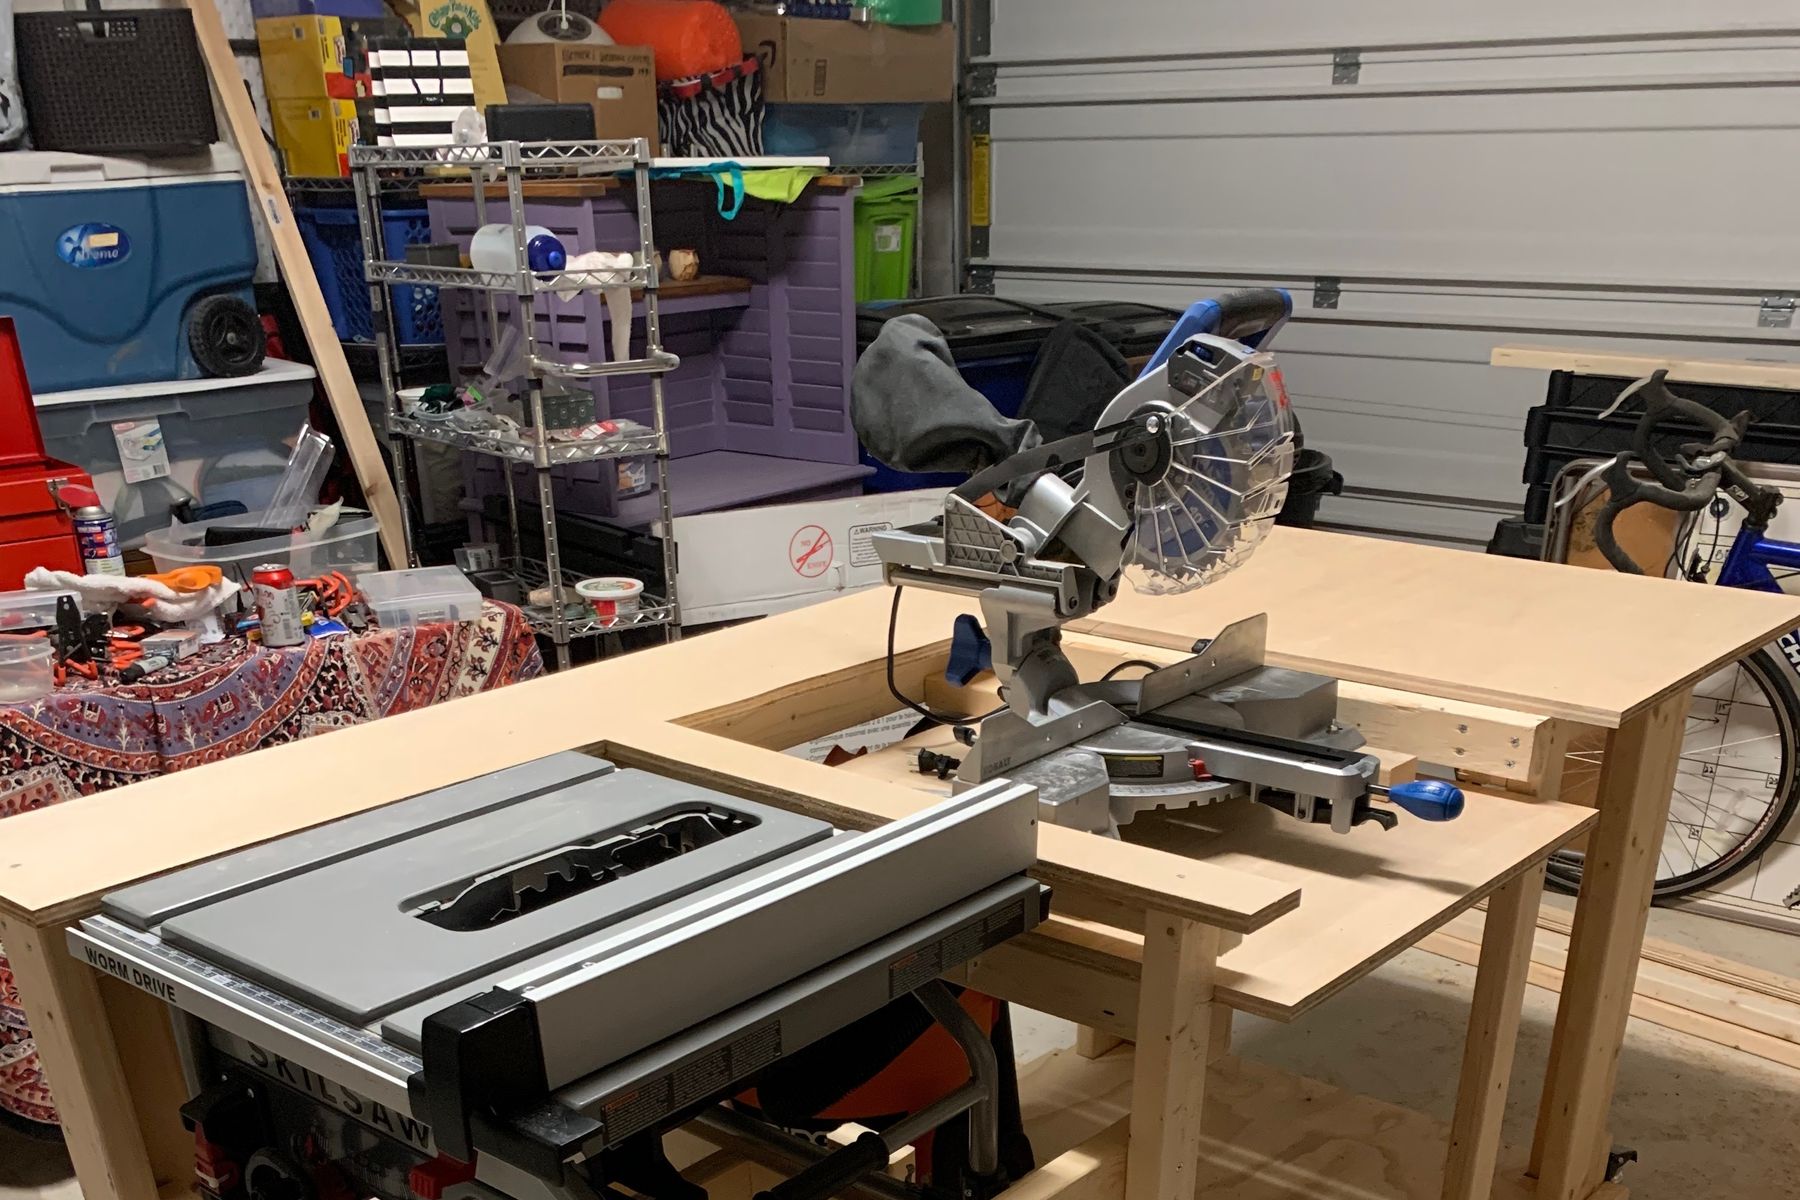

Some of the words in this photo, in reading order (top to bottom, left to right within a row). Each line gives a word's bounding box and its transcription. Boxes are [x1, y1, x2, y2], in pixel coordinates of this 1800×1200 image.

[84, 945, 130, 981] WORM
[132, 968, 177, 1003] DRIVE
[247, 1041, 431, 1150] SKILSAW
